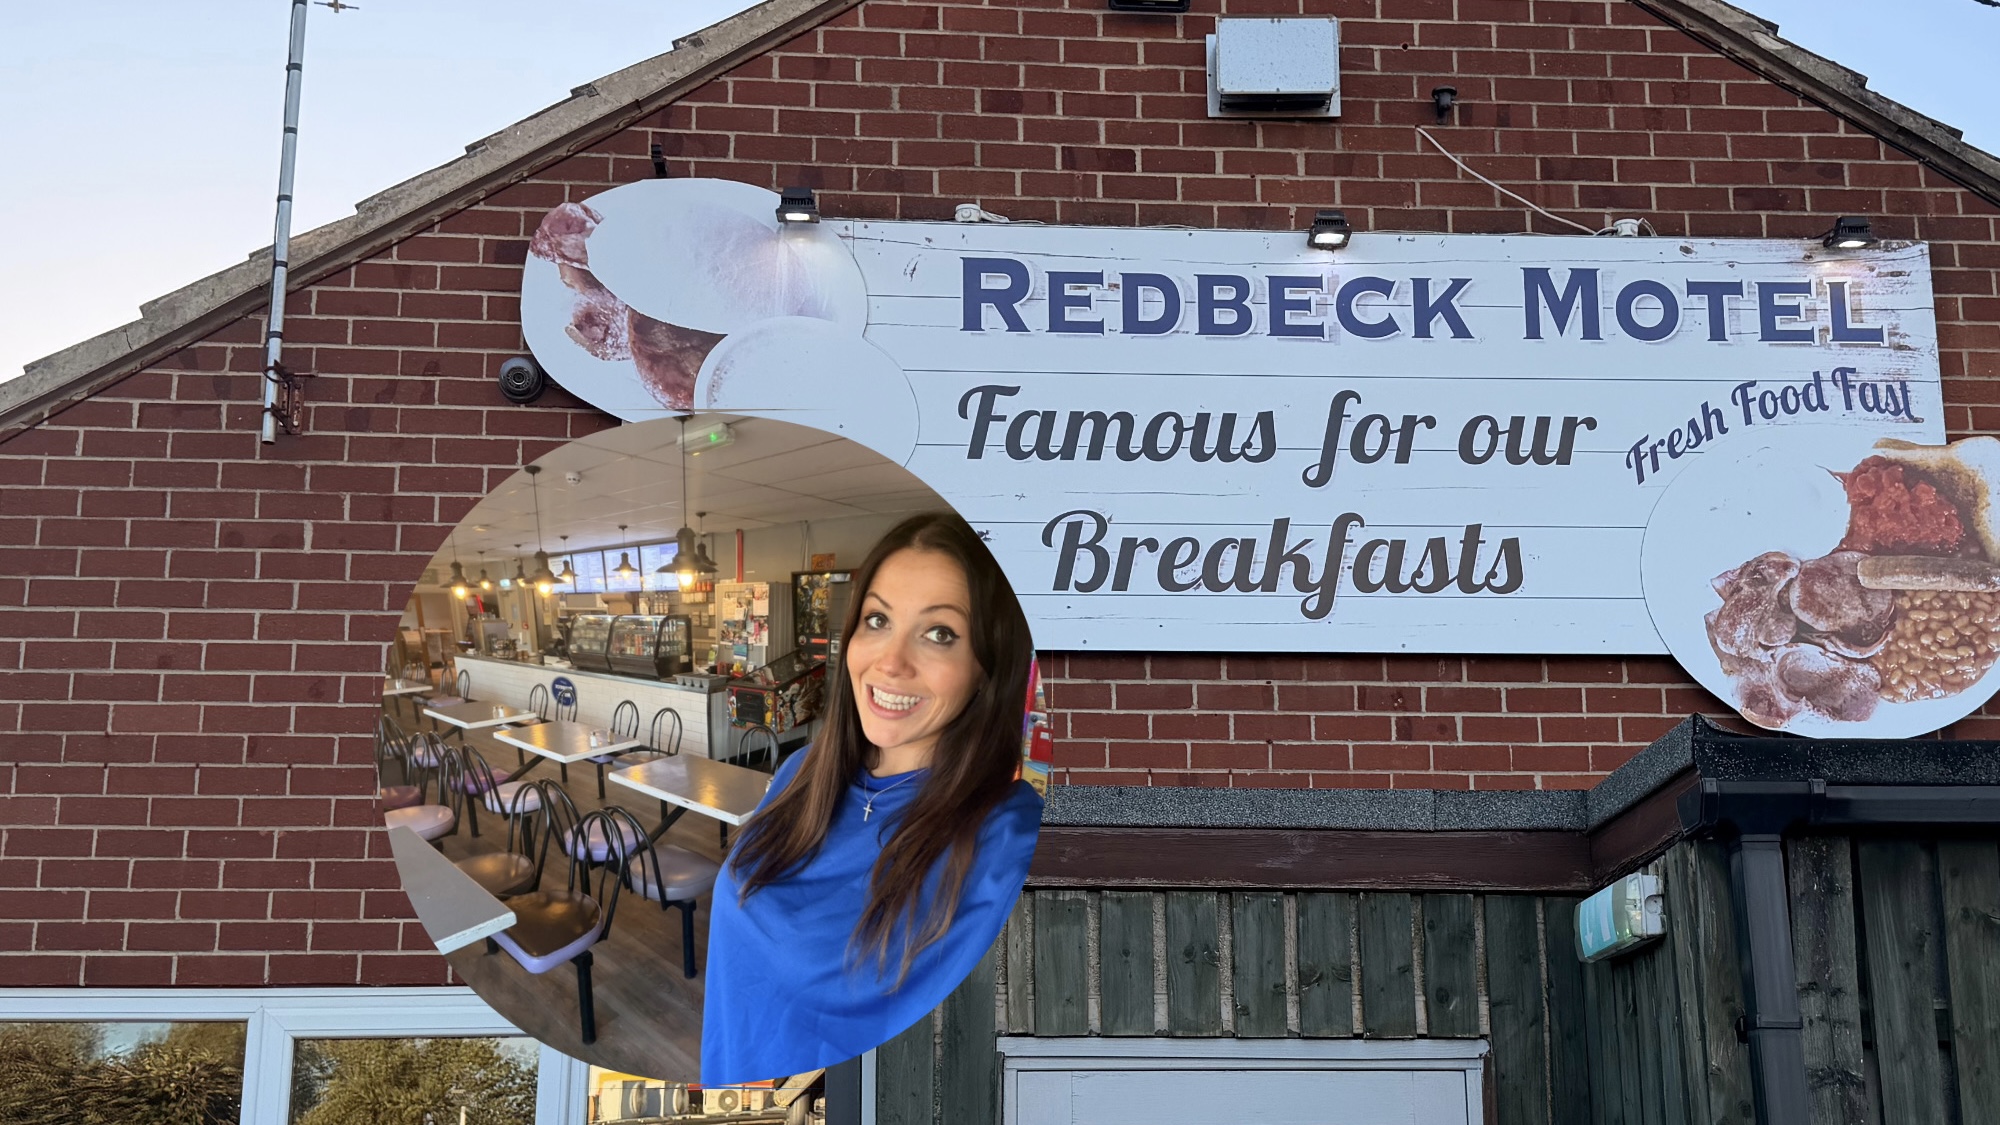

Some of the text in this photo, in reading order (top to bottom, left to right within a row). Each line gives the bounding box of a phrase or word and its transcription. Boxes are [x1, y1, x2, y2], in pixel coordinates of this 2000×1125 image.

[960, 257, 1886, 343] REDBECK MOTEL
[958, 385, 1598, 488] Famous for our
[1625, 367, 1916, 485] Fresh Food Fast
[1042, 510, 1524, 620] Breakfasts
